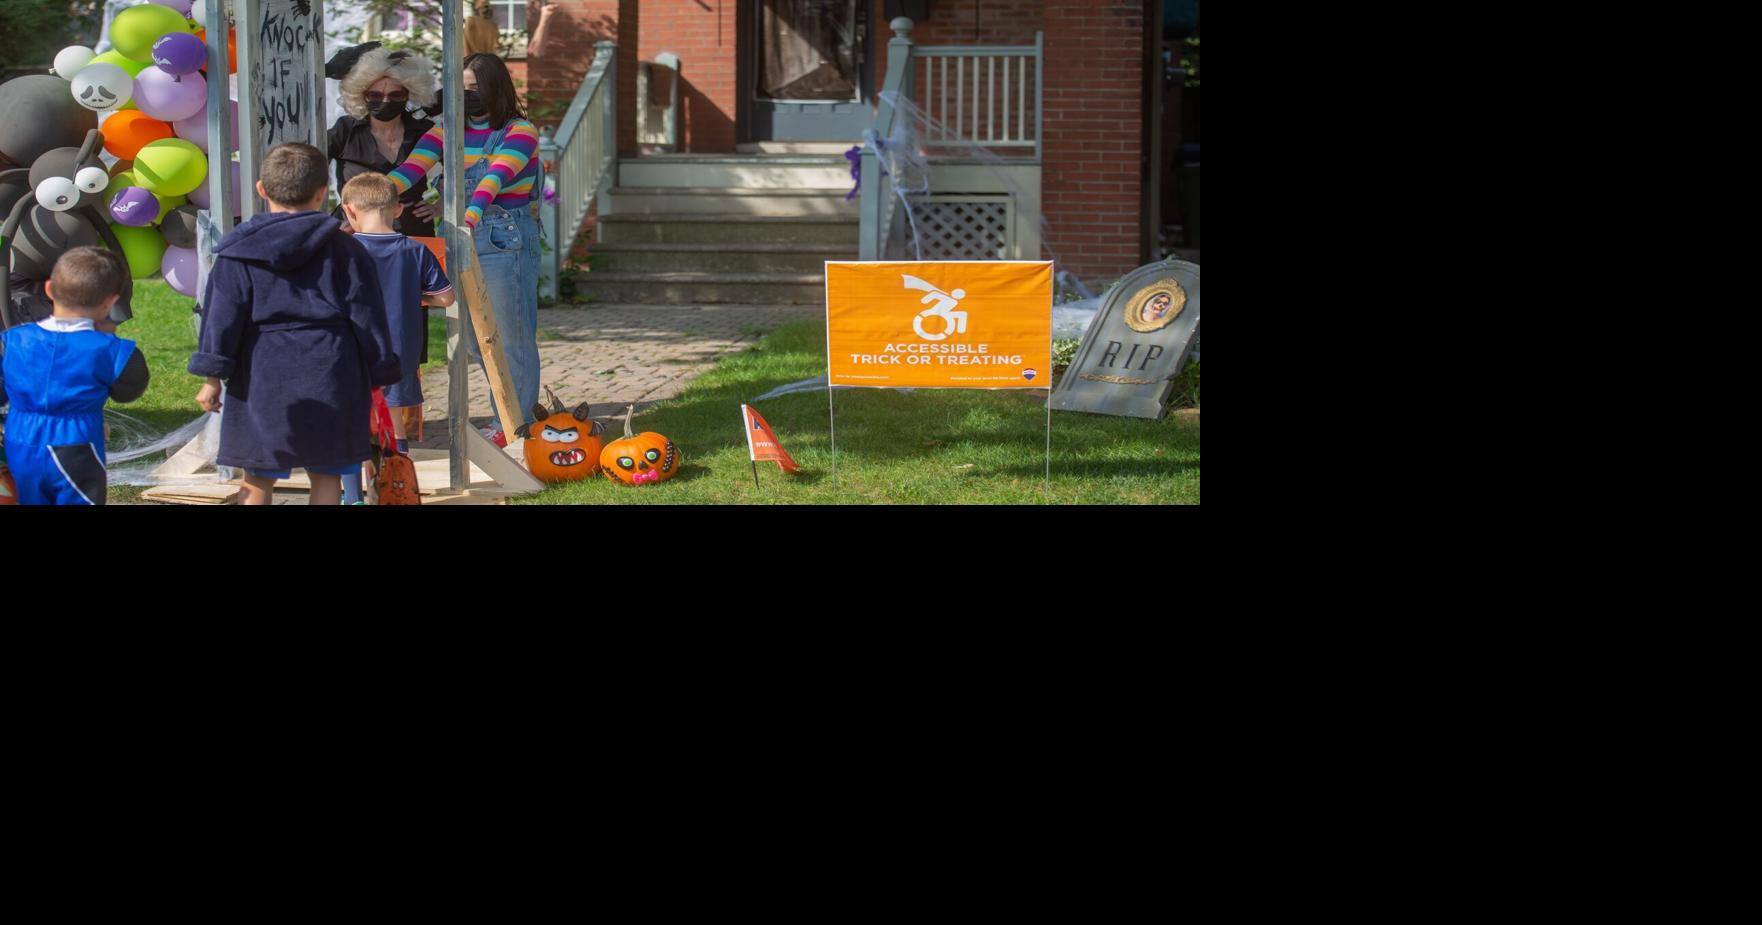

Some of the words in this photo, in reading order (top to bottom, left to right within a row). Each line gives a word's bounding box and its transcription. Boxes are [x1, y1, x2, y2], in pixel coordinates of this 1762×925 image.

[261, 3, 321, 53] KNOCK
[270, 57, 291, 88] IF
[262, 81, 300, 145] YOU
[850, 353, 901, 365] TRICK
[906, 354, 931, 365] OR
[937, 354, 1022, 365] TREATING
[884, 343, 988, 353] ACCESSIBLE
[1097, 340, 1164, 370] RIP
